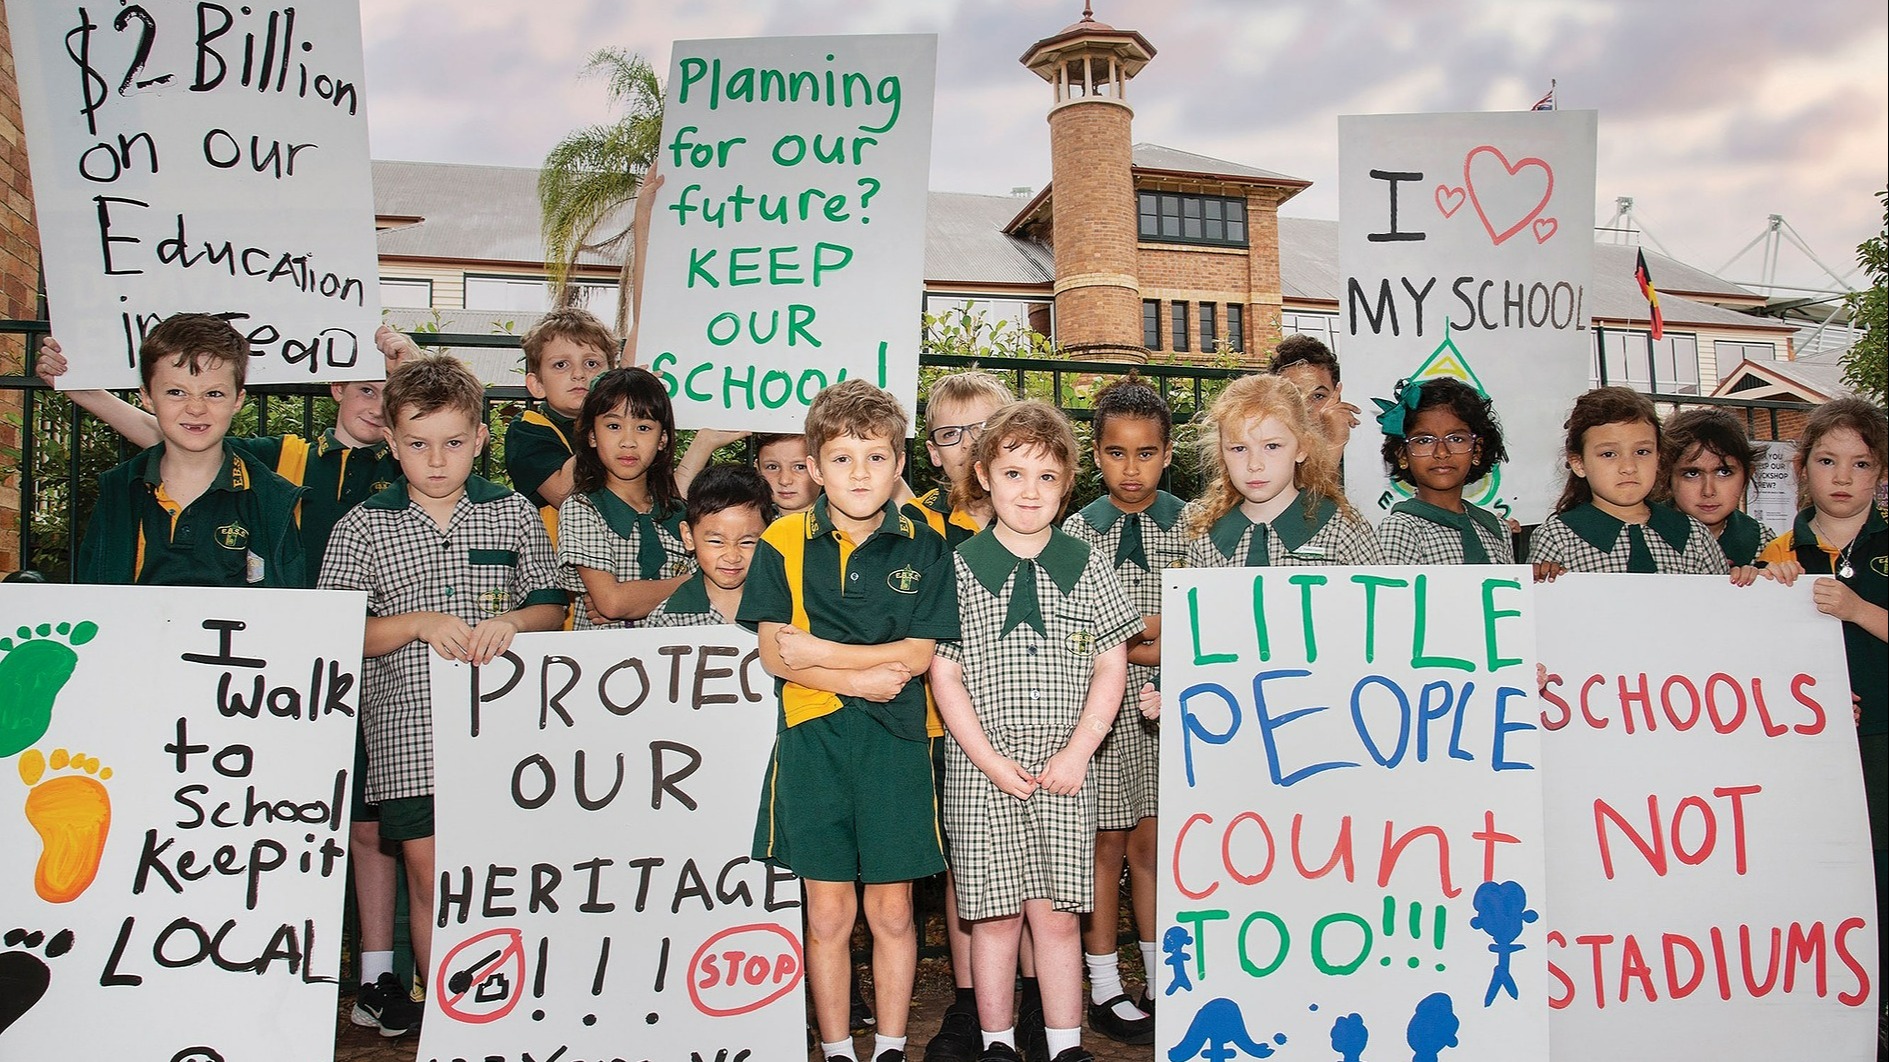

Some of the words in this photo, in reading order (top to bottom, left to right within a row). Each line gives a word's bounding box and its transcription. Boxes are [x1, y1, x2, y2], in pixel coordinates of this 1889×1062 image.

[66, 6, 177, 135] $2
[189, 2, 357, 116] Billion
[678, 54, 902, 133] Planning
[79, 129, 159, 183] on
[203, 128, 318, 178] our
[668, 126, 747, 169] for
[772, 133, 879, 166] our
[668, 177, 881, 228] future?
[1367, 169, 1426, 242] I
[687, 241, 854, 289] KEEP
[706, 303, 822, 348] OUR
[1347, 276, 1437, 337] MY
[1451, 276, 1586, 333] SCHOOL
[181, 619, 267, 668] I
[1187, 574, 1524, 673] LITTLE
[1179, 669, 1538, 788] PEOPLE
[1540, 672, 1827, 738] SCHOOLS
[165, 717, 253, 778] to
[511, 740, 702, 811] OUR
[299, 833, 345, 878] it
[1594, 784, 1762, 880] NOT
[437, 856, 802, 928] HERITAGE
[99, 916, 339, 987] LOCAL
[699, 949, 797, 989] STOP
[1548, 916, 1871, 1009] STADIUMS
